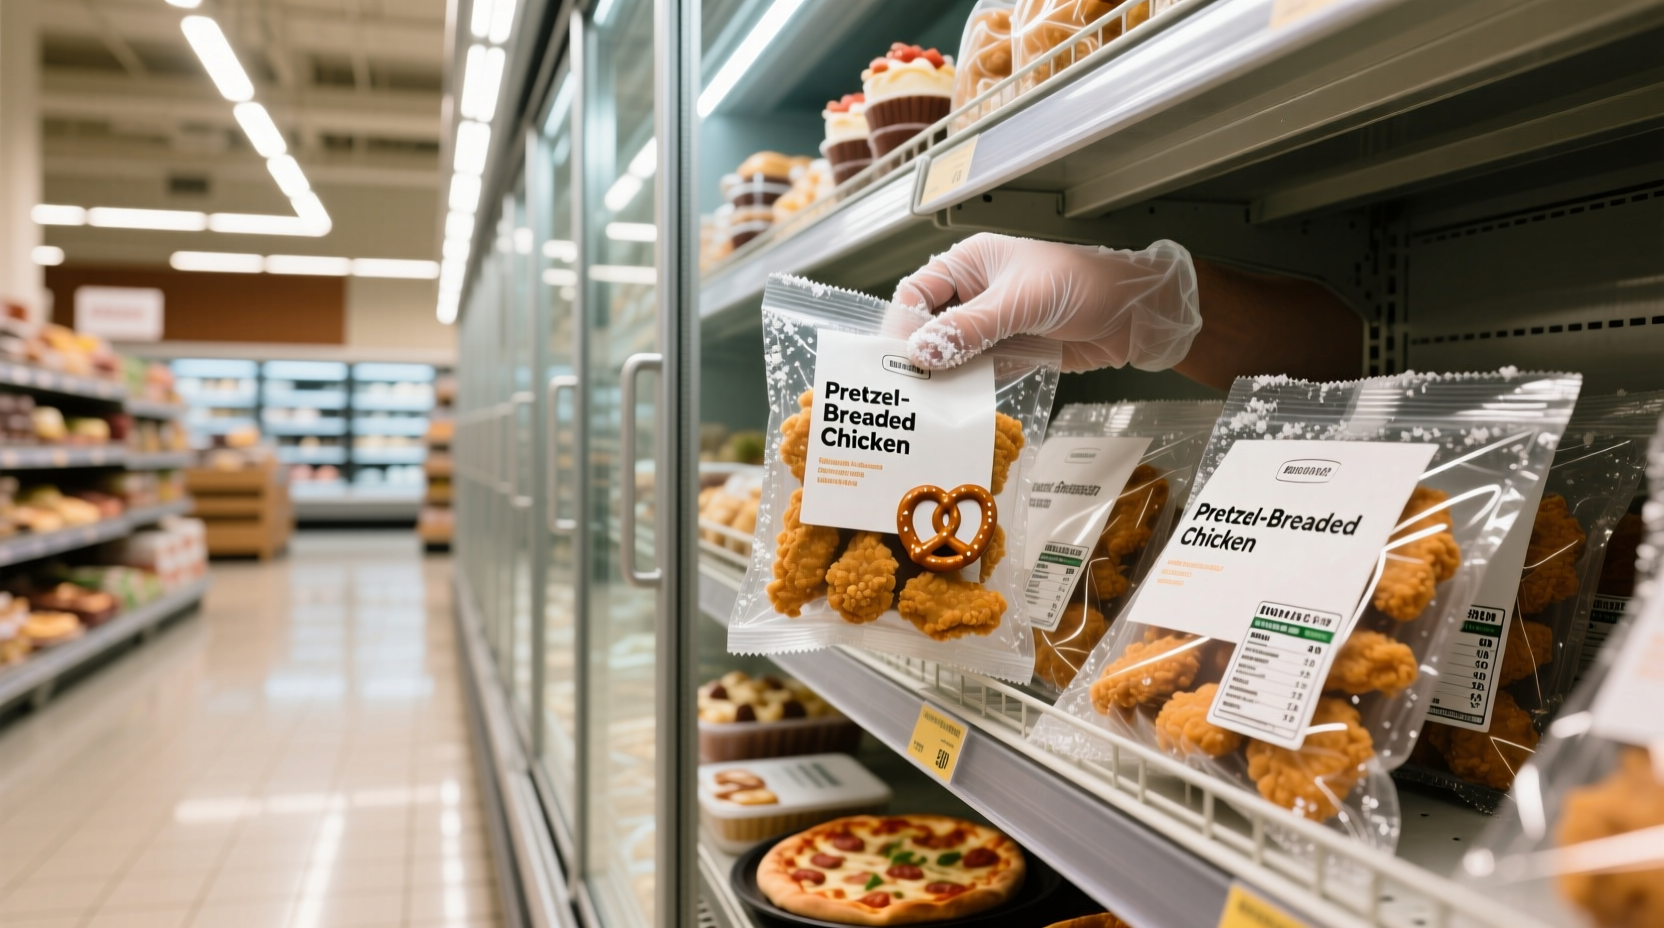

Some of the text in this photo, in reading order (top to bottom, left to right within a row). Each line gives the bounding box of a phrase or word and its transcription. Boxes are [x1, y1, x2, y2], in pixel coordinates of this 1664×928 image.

[825, 381, 910, 406] Pretzel-
[823, 403, 916, 431] Breaded
[821, 427, 910, 455] Chicken
[1193, 502, 1363, 536] Pretzel-Breaded
[1180, 527, 1257, 553] Chicken
